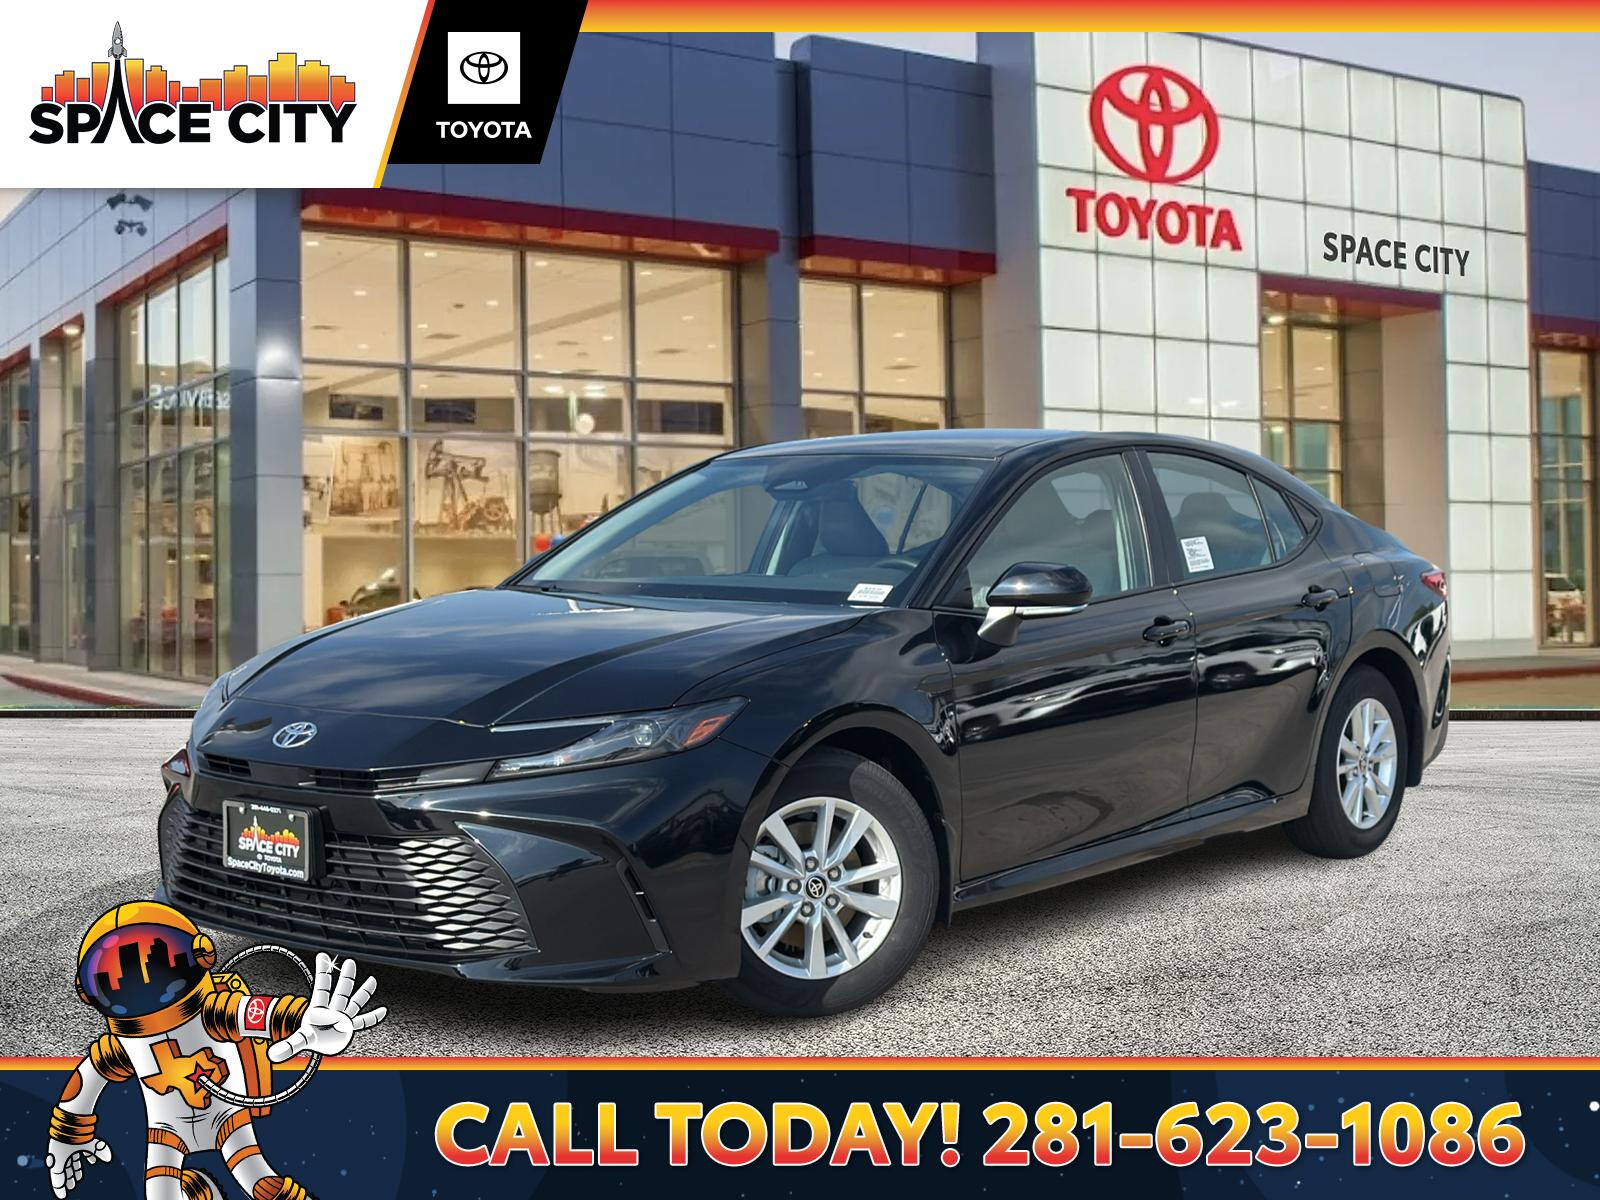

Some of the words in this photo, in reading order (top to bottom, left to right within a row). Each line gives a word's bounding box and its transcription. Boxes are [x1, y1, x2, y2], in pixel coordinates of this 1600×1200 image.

[1066, 187, 1242, 251] TOYOTA
[1323, 232, 1407, 270] SPACE
[1414, 244, 1471, 277] CITY
[238, 826, 274, 854] SPACE
[274, 843, 300, 858] CITY
[227, 856, 304, 878] SpaceCityToyota.com
